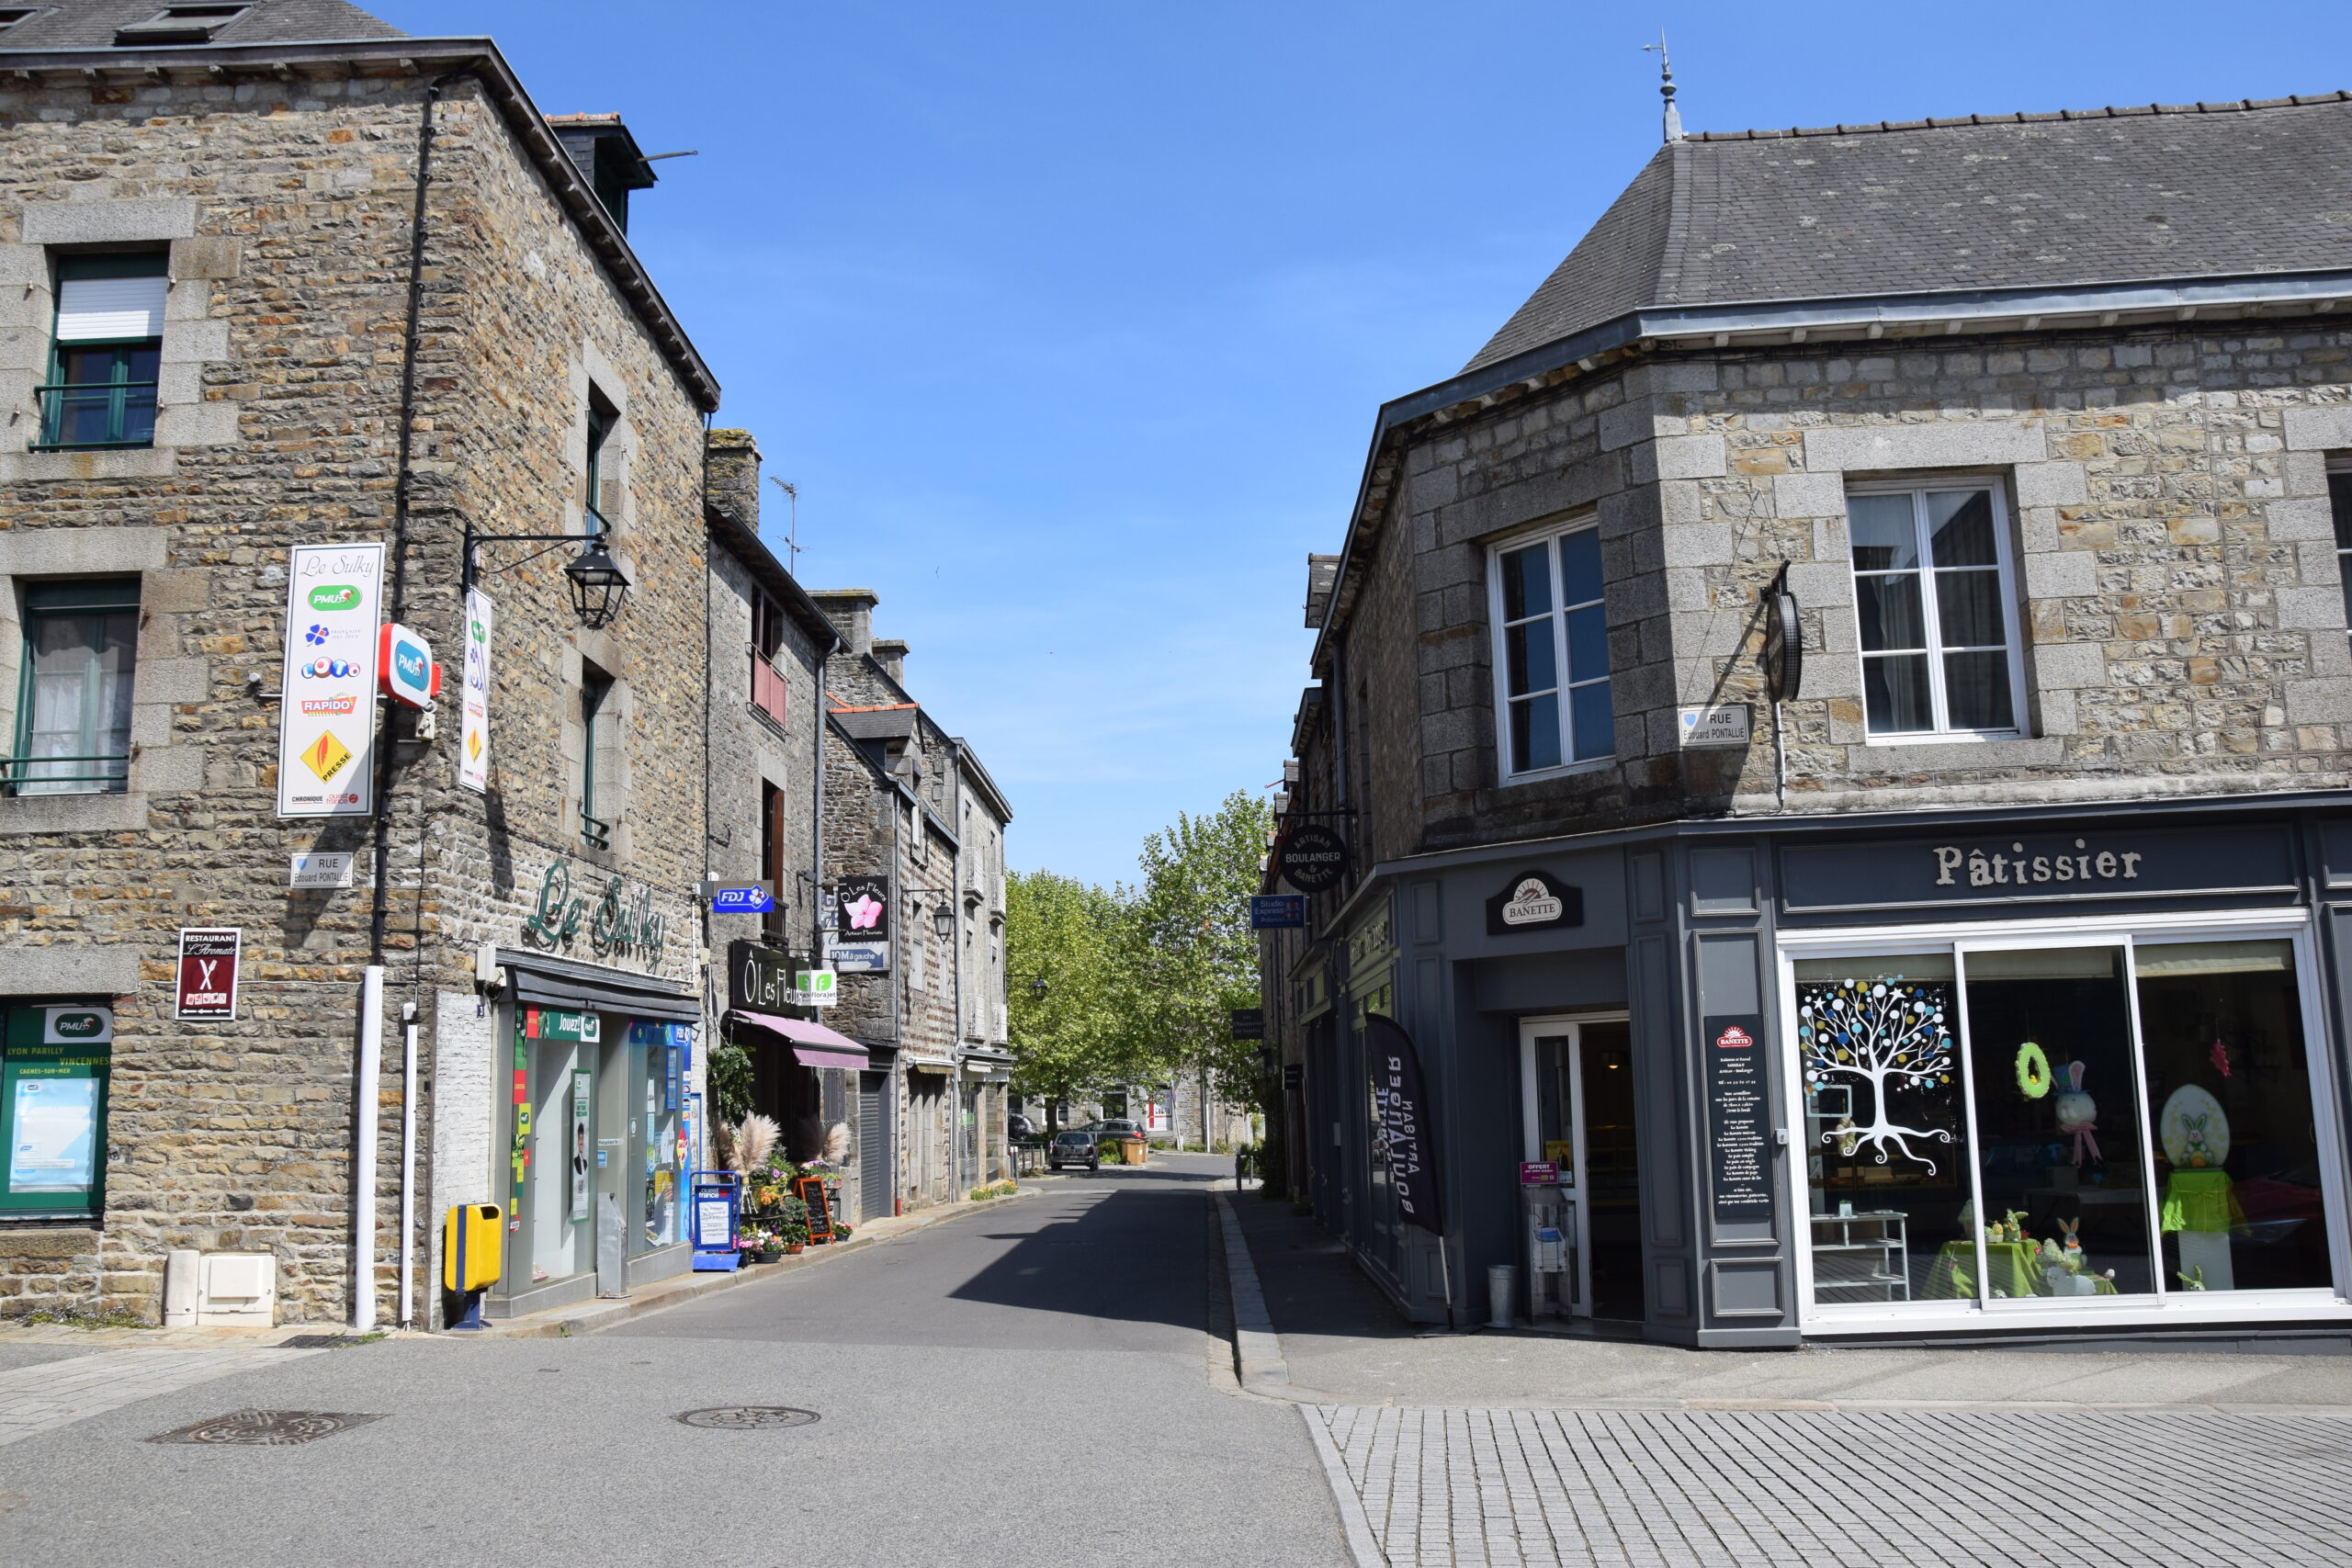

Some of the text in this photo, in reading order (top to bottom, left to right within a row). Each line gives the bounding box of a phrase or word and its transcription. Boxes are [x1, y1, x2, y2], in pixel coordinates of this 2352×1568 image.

[300, 554, 375, 578] Le Sulky
[313, 594, 338, 604] PMU
[301, 657, 360, 678] LOTO
[398, 653, 415, 674] PMU
[304, 701, 351, 711] RAPIDO
[1710, 713, 1732, 724] RUE
[322, 752, 351, 782] PRESSE
[1294, 834, 1331, 850] ARTISAN
[318, 858, 339, 868] RUE
[1285, 852, 1340, 863] BOULANGER
[1932, 838, 2143, 886] Pâtissier
[1309, 863, 1317, 874] &
[1294, 866, 1334, 883] BANETTE
[720, 891, 745, 902] FDJ
[848, 885, 865, 896] Les
[865, 882, 888, 902] Fleurs
[1260, 899, 1284, 908] Studio
[528, 861, 664, 964] Le Sulky
[1254, 908, 1284, 916] Express
[1509, 903, 1555, 918] BANETTE
[185, 934, 236, 942] RESTAURANT
[854, 953, 876, 962] gauche
[758, 963, 775, 1006] Les
[776, 968, 802, 1008] Fleurs
[59, 1021, 83, 1031] PMU
[559, 1013, 581, 1032] Jouez!
[31, 1046, 64, 1055] PARILLY
[59, 1056, 110, 1066] VINCENNES
